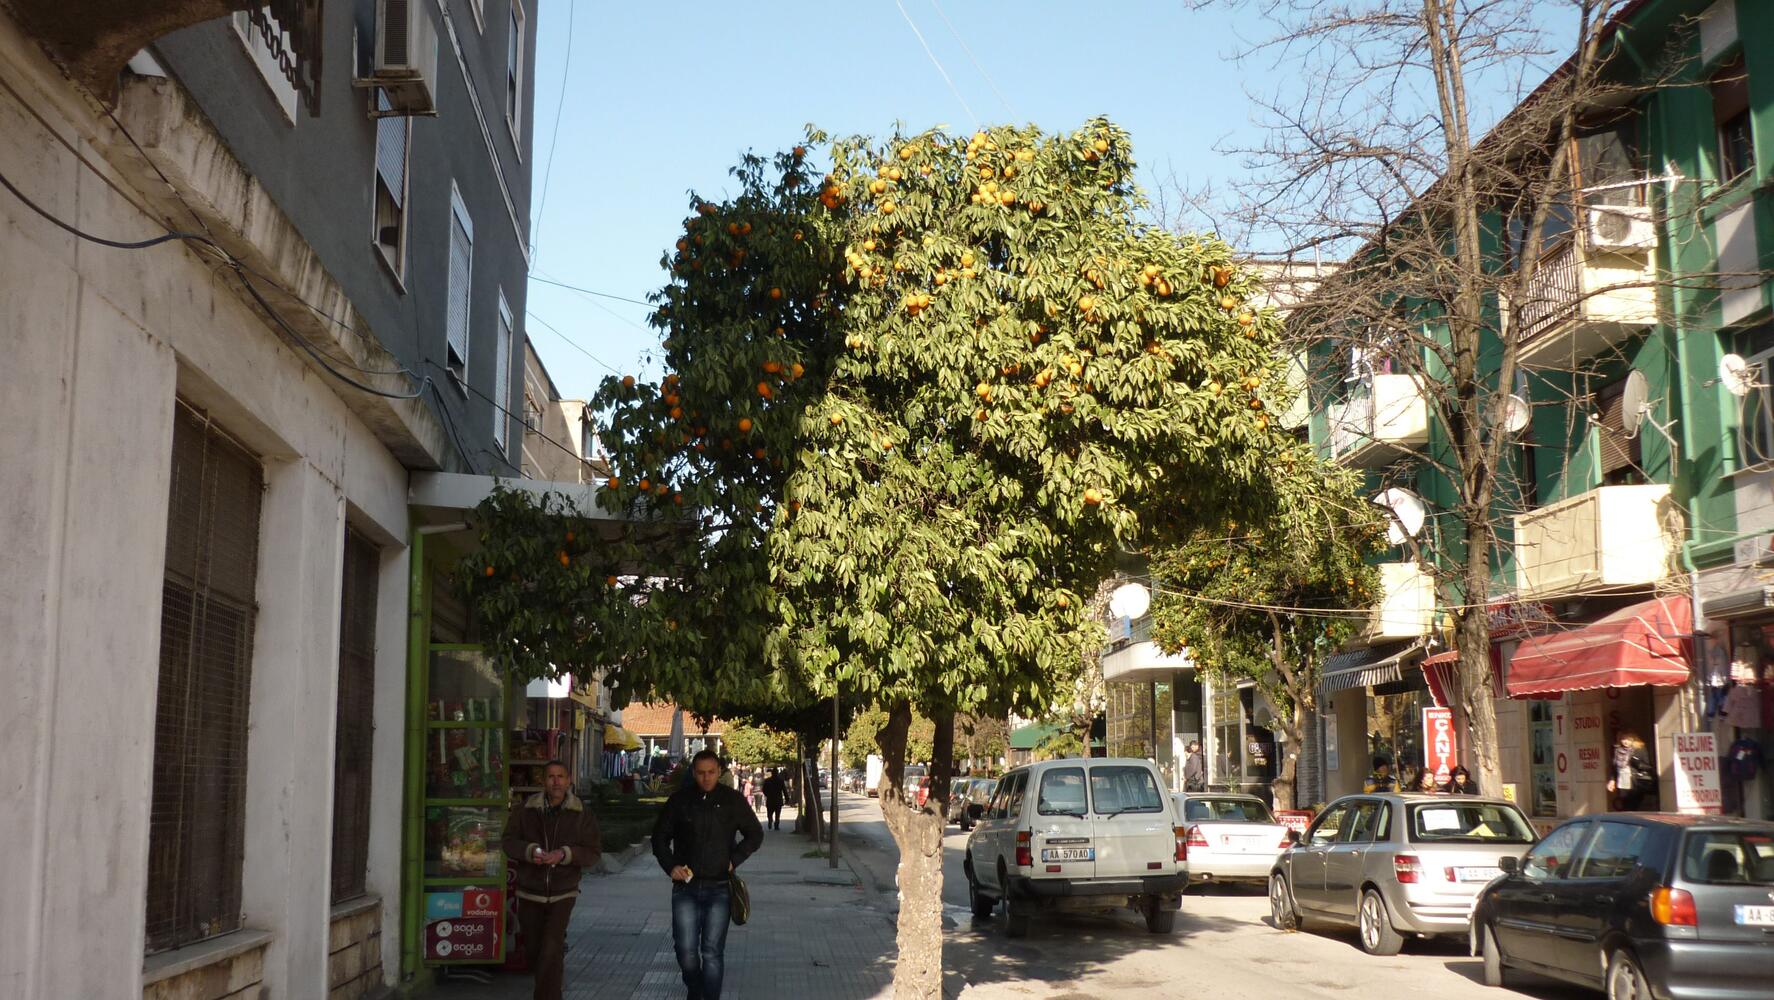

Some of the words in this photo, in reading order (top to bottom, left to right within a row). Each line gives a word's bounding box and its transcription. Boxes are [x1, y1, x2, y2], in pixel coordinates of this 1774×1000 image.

[1574, 717, 1600, 729] STUDIO
[1677, 735, 1713, 752] BLEJME
[1680, 756, 1715, 771] FLORI
[1693, 774, 1704, 787] TE
[1049, 850, 1060, 859] AA
[453, 923, 484, 937] eagle
[453, 943, 484, 956] eagle
